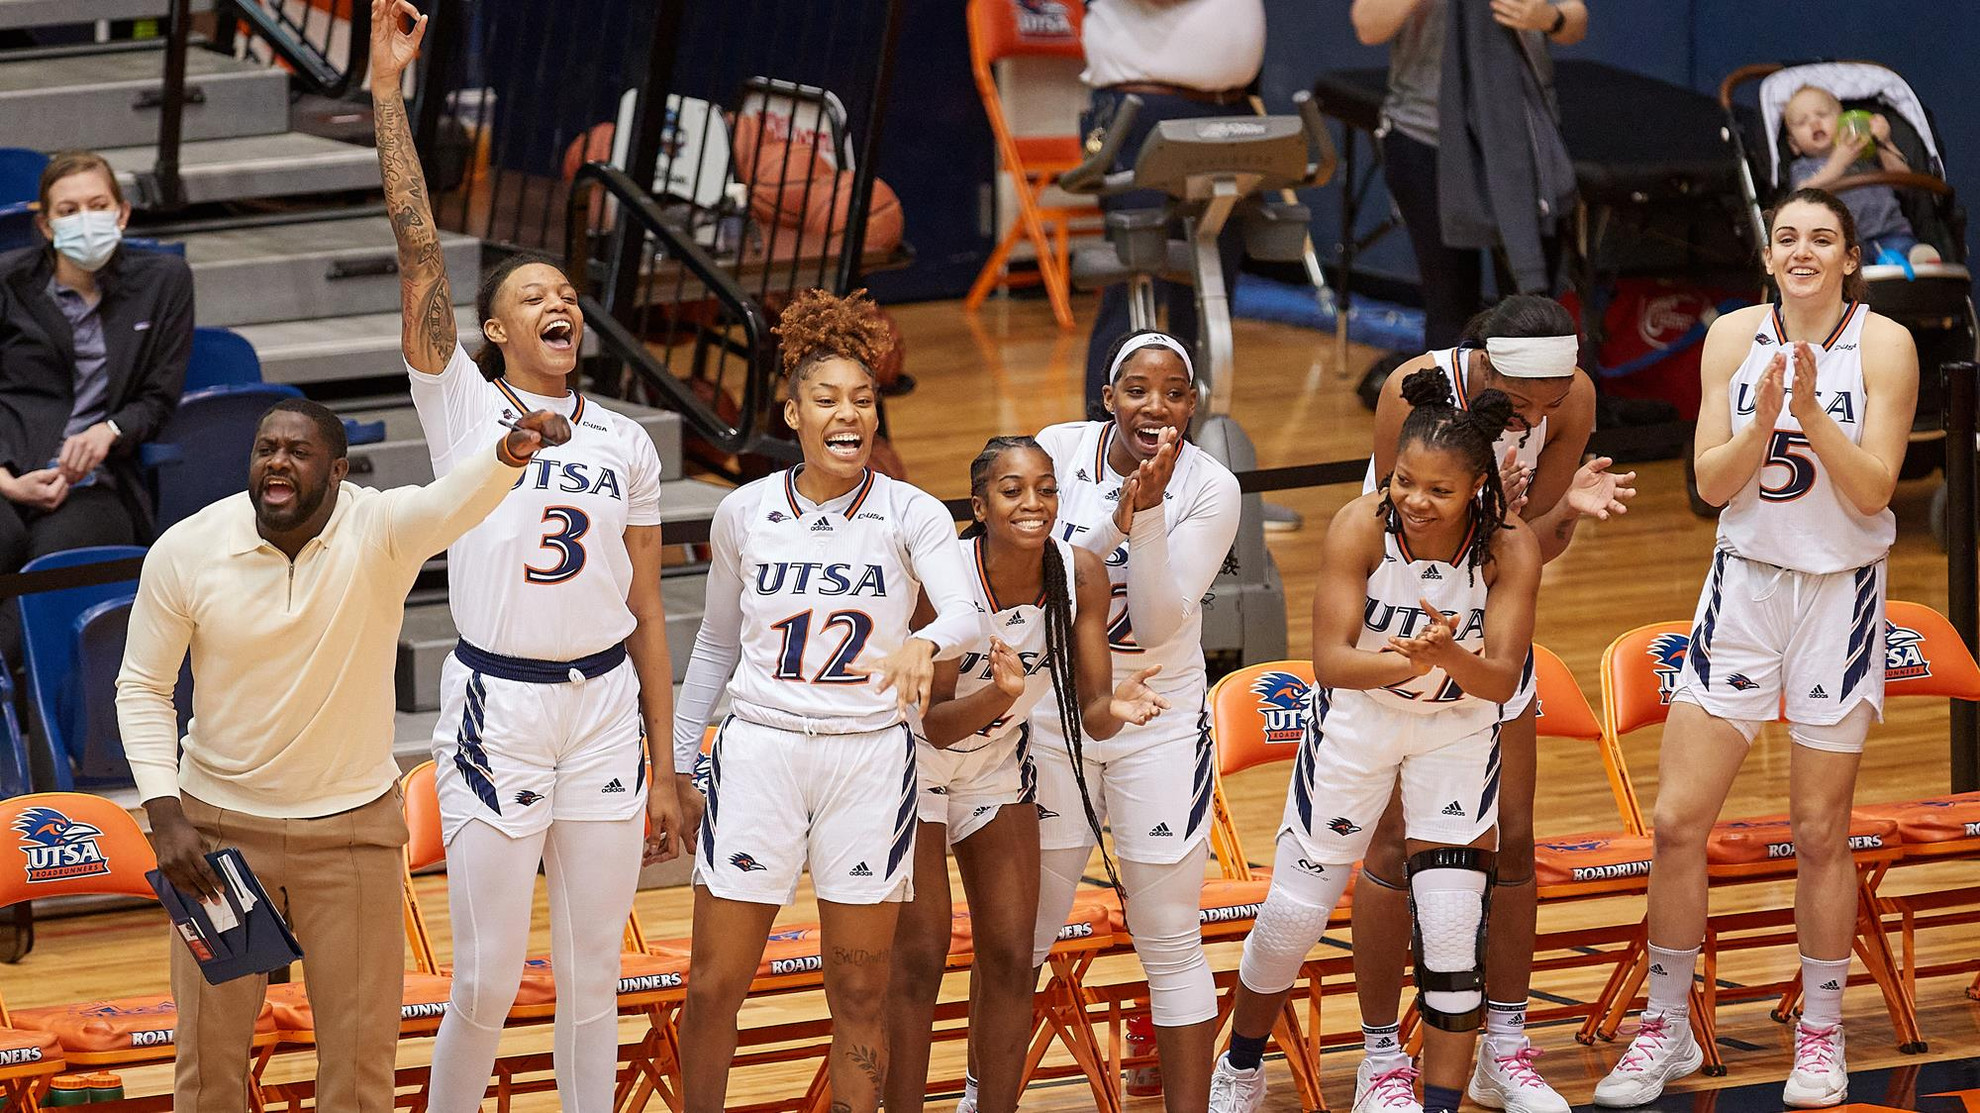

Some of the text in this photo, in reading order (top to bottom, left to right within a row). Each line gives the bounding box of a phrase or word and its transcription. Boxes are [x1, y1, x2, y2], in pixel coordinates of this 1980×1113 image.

[1737, 382, 1856, 424] UA
[511, 458, 622, 500] TSA
[1759, 428, 1819, 503] 5
[524, 504, 592, 586] 3
[755, 562, 887, 597] UTSA
[1005, 619, 1026, 627] adidas
[1364, 595, 1485, 641] UTA
[769, 608, 875, 685] 12
[1884, 644, 1923, 669] SA
[1441, 809, 1466, 817] adidas
[29, 841, 100, 869] UTSA
[35, 863, 99, 878] ROADRUNNERS
[771, 956, 823, 974] ROAD
